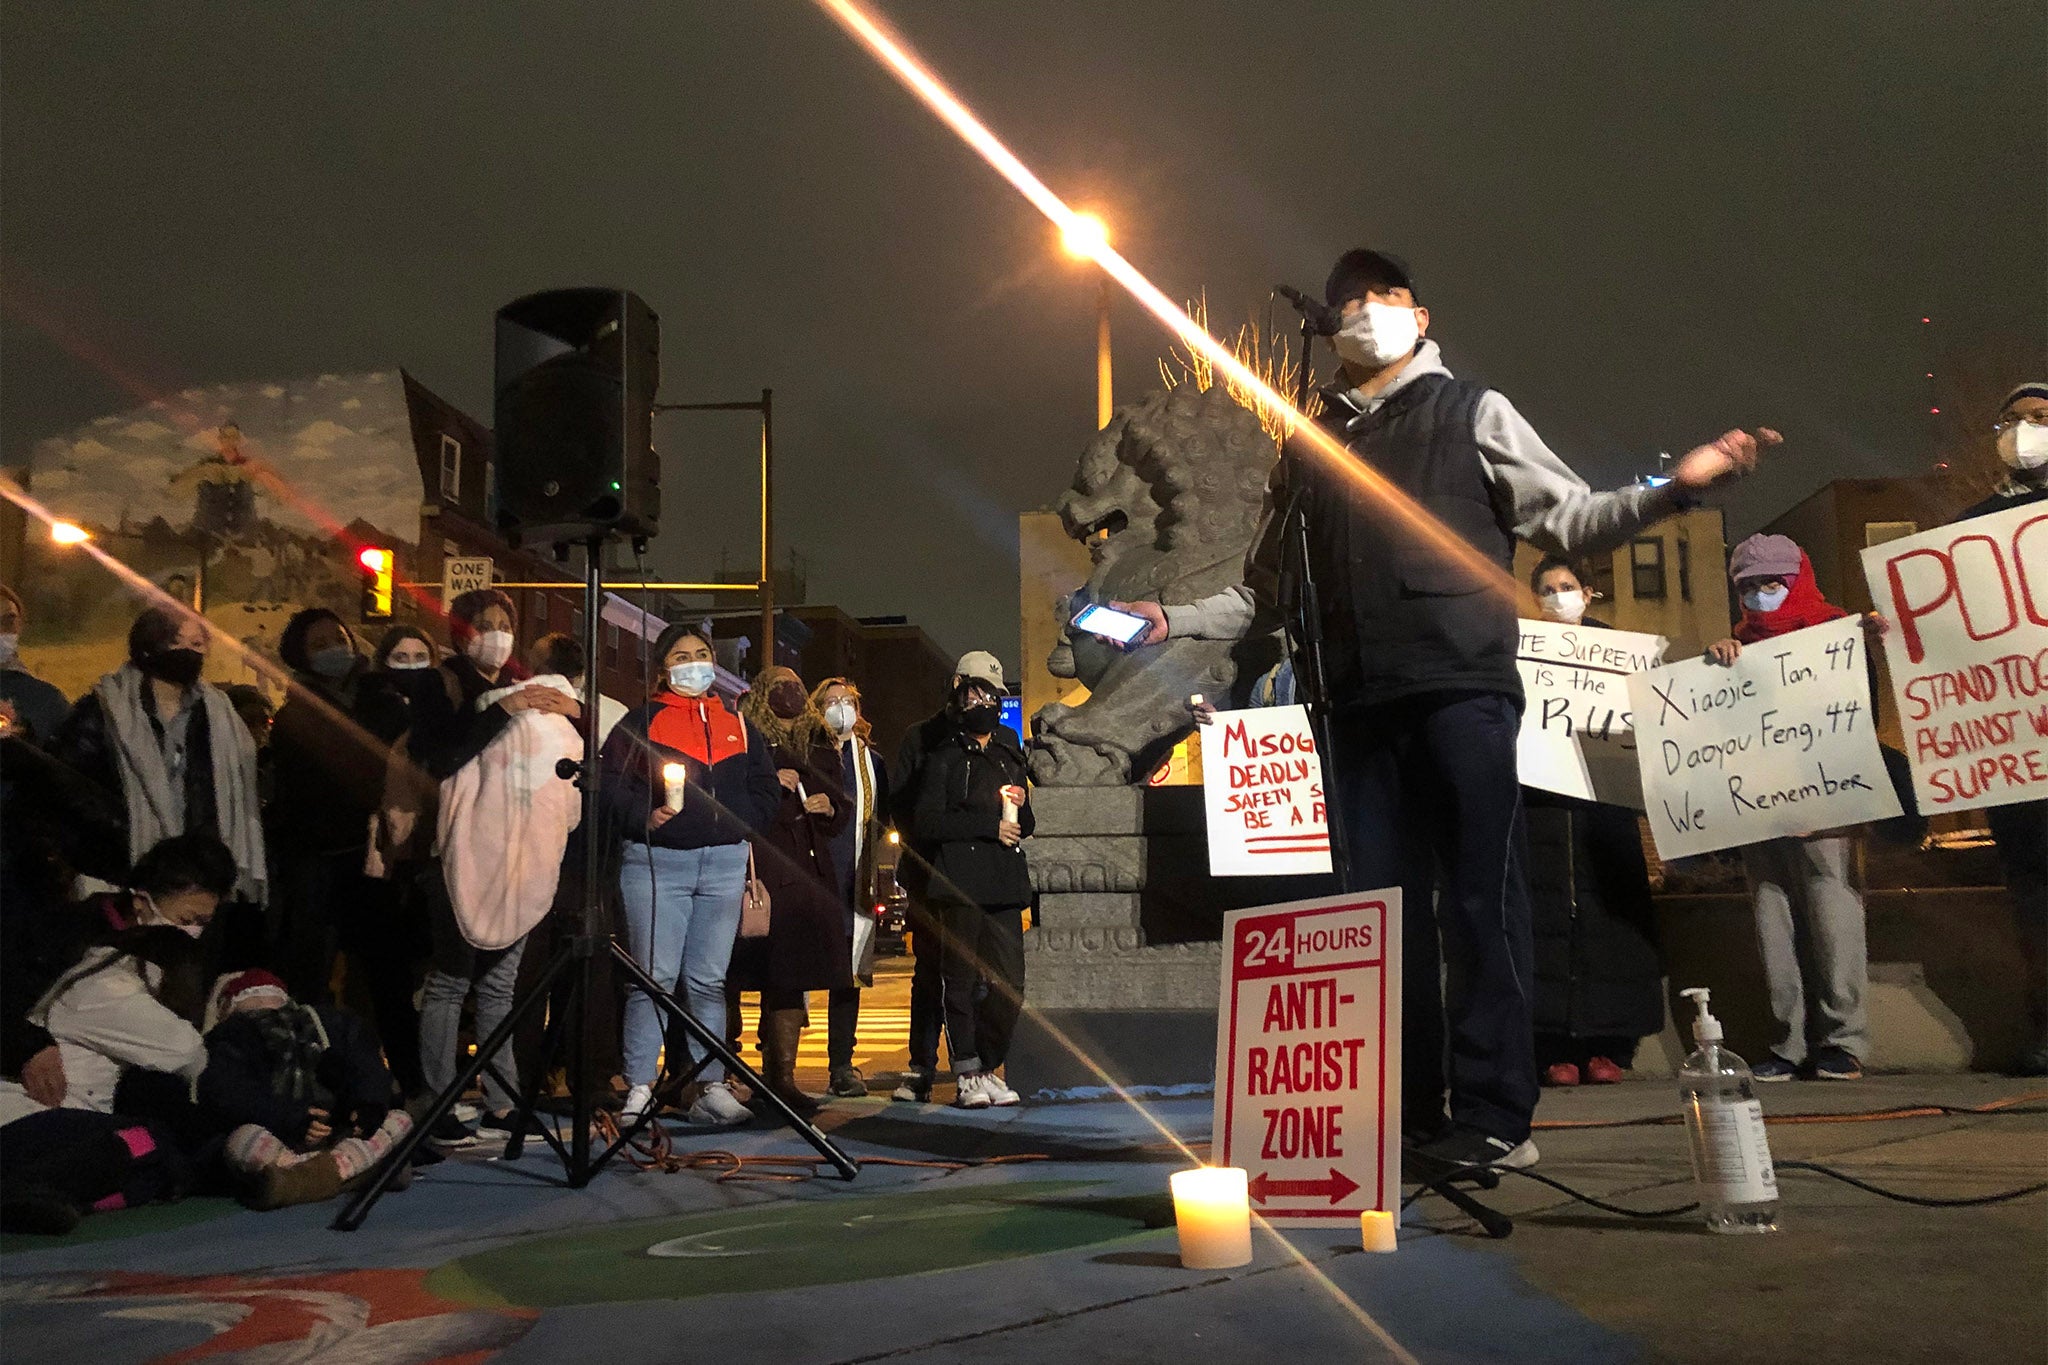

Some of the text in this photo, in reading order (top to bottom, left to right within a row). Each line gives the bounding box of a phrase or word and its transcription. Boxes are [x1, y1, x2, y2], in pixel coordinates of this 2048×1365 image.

[451, 579, 482, 590] WAY
[452, 563, 484, 575] ONE
[1535, 665, 1606, 695] is the
[1651, 637, 1856, 726] Xiaojie Tan, 49
[1905, 664, 1997, 720] STAND
[1661, 699, 1862, 776] Daoyou Feng, 44
[1915, 710, 2021, 764] AGAINST
[1224, 787, 1291, 812] SAFETY
[1663, 762, 1873, 834] We Remember
[1928, 750, 2048, 803] SUPRE
[1244, 811, 1272, 829] BE
[1291, 805, 1303, 827] A
[1243, 925, 1372, 967] 24 HOURS
[1262, 978, 1354, 1033] ANTI-
[1248, 1038, 1365, 1096] RACIST
[1261, 1105, 1343, 1159] ZONE
